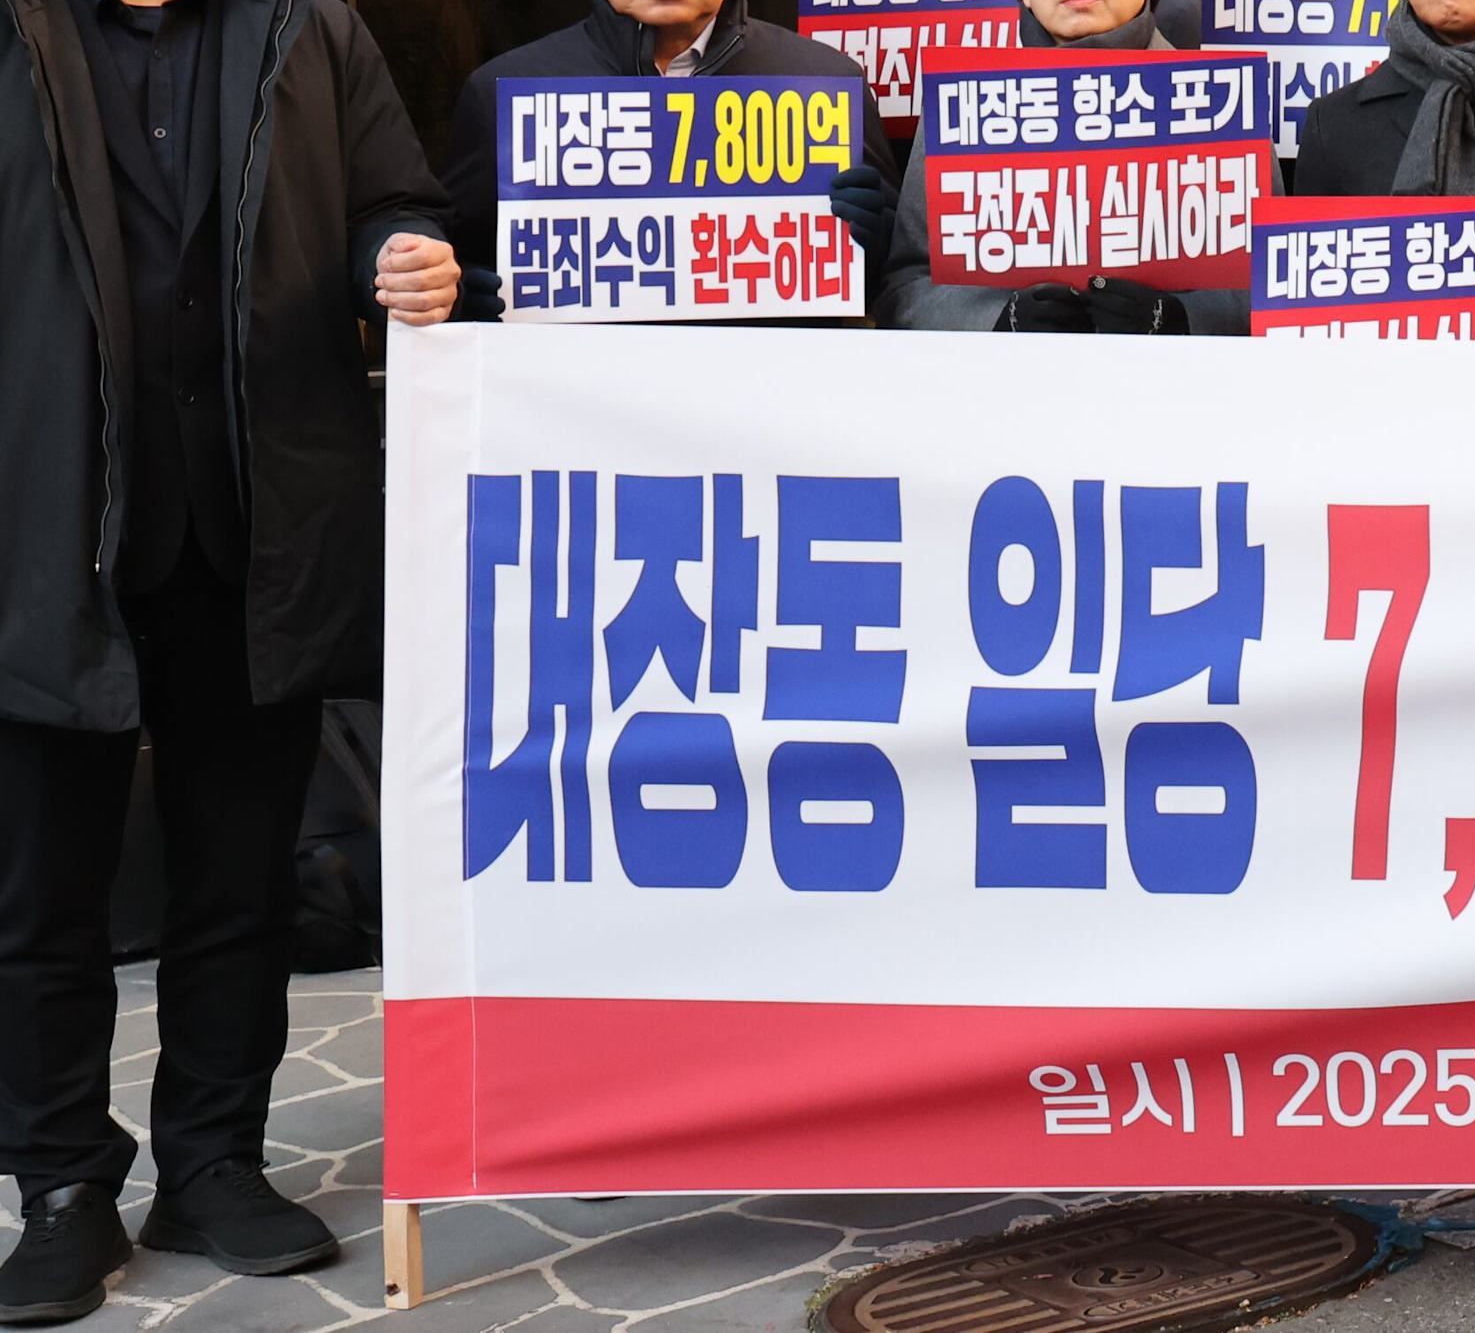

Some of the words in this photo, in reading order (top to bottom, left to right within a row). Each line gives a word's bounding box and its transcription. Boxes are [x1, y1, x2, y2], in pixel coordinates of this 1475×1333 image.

[512, 91, 653, 186] 대장동
[666, 90, 851, 187] 7,800억
[938, 77, 1059, 146] 대장동
[1073, 73, 1156, 142] 항소
[1170, 65, 1254, 136] 포기
[510, 215, 676, 309] 범죄수익
[691, 212, 854, 304] 환수하라
[940, 165, 1090, 273] 국정조사
[1100, 153, 1260, 268] 실시하라
[1267, 226, 1391, 299] 대장동
[462, 470, 908, 892] 대장동
[966, 475, 1265, 893] 일당
[1028, 1058, 1197, 1136] 일시
